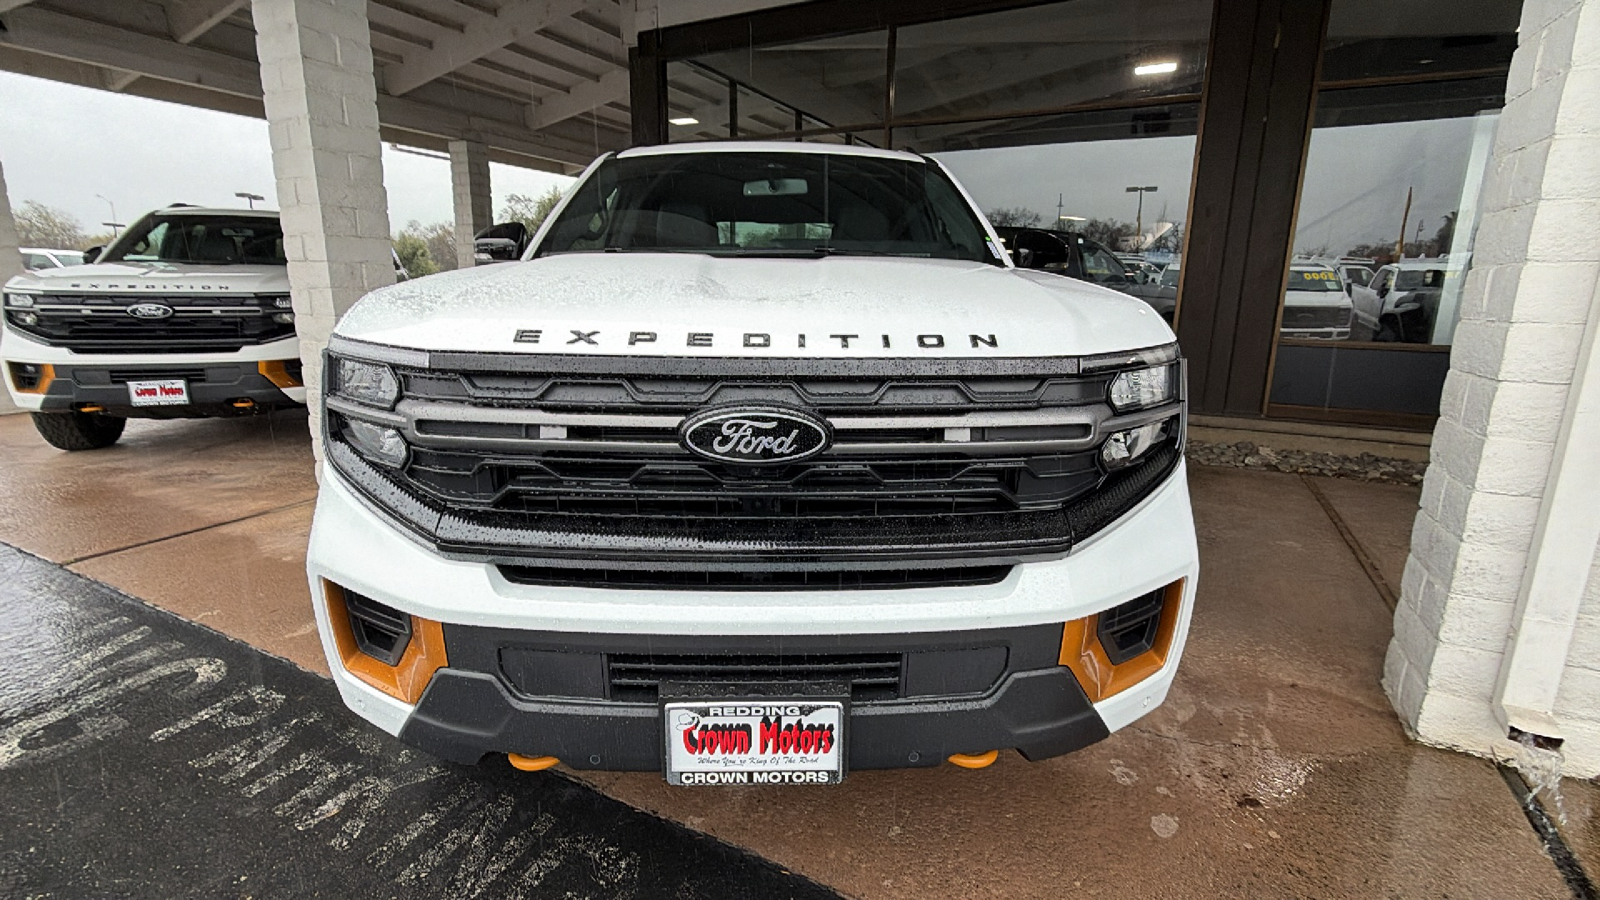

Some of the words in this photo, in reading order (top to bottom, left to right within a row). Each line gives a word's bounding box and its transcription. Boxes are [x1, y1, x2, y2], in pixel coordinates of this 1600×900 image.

[71, 283, 229, 291] EXPEDITION
[513, 329, 999, 348] EXPEDITION
[713, 419, 799, 454] Ford
[709, 706, 800, 716] REDDING
[683, 722, 752, 756] Crown
[759, 716, 835, 756] Motors
[698, 756, 720, 764] Where
[749, 756, 768, 766] King
[770, 756, 781, 765] Of
[783, 756, 796, 764] The
[799, 756, 819, 764] Road
[681, 772, 748, 784] CROWN
[752, 771, 829, 783] MOTORS
